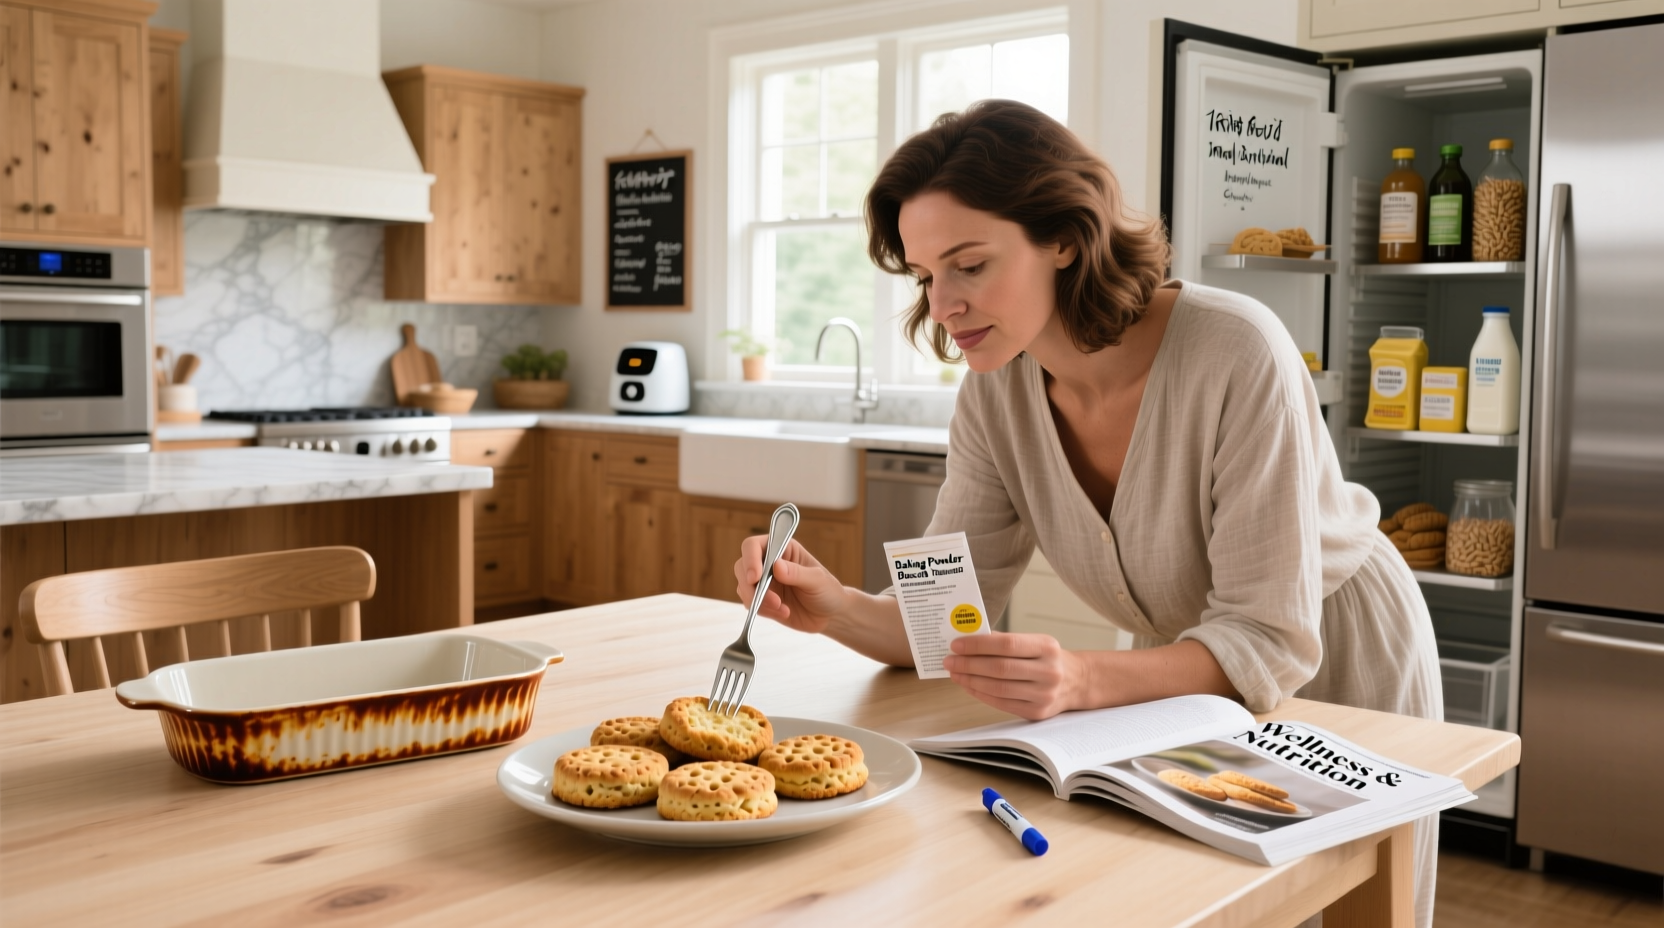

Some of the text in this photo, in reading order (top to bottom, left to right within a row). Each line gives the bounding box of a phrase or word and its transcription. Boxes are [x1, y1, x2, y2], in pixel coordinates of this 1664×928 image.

[1233, 731, 1367, 790] Nutrition
[1262, 723, 1373, 776] Wellness
[1376, 772, 1402, 787] &
